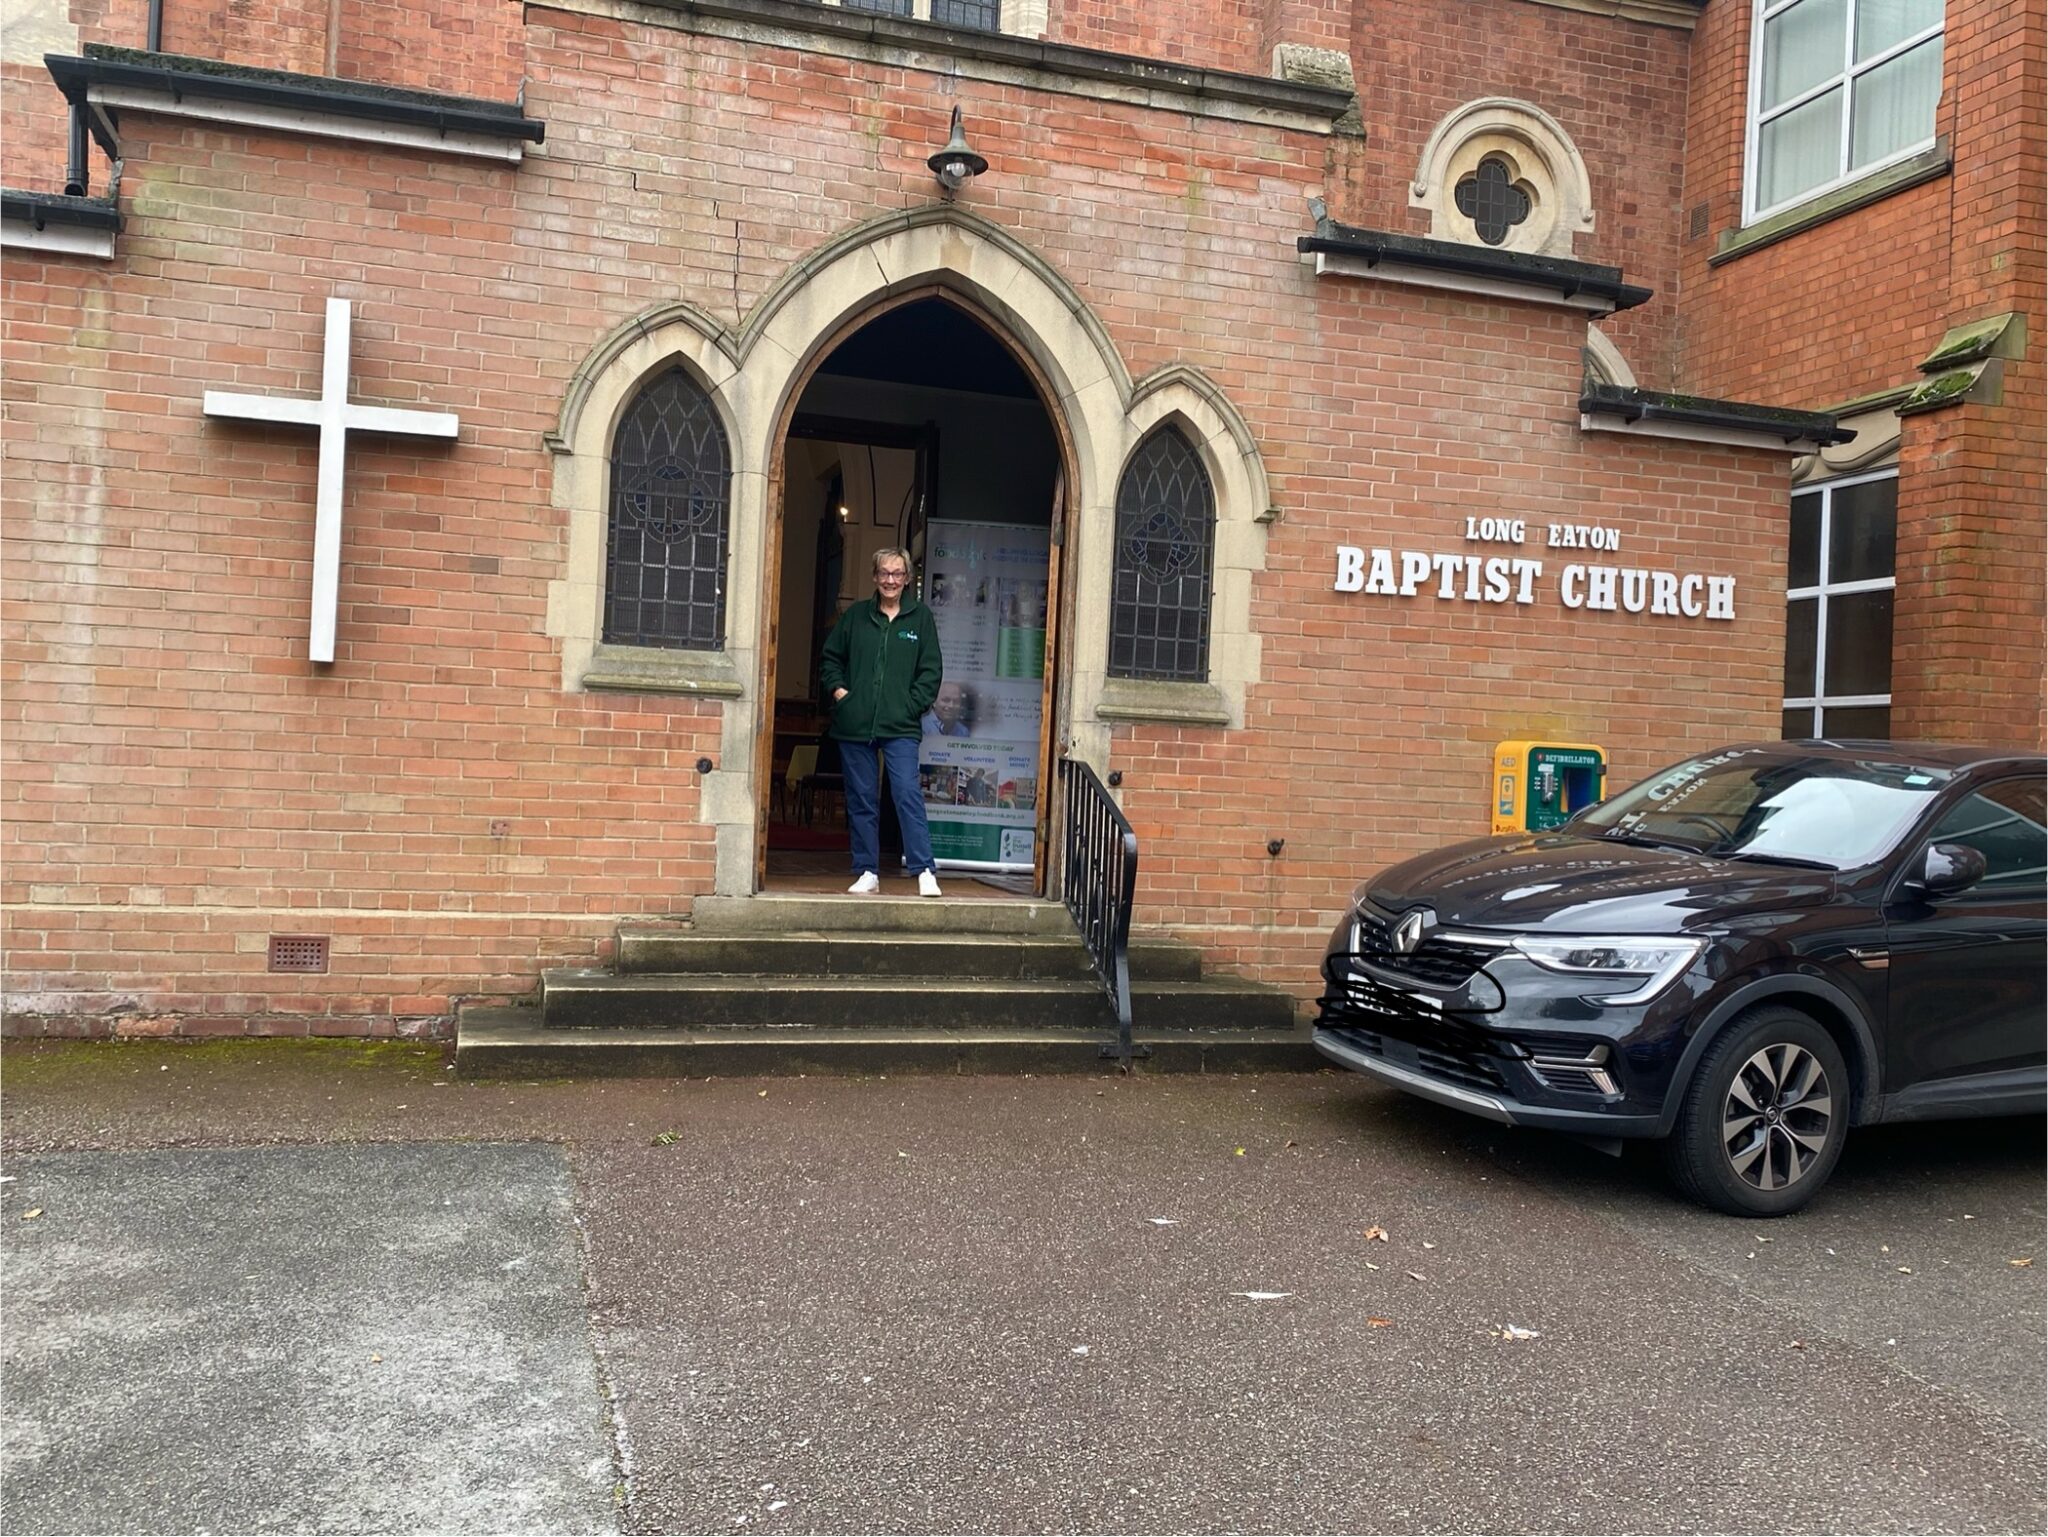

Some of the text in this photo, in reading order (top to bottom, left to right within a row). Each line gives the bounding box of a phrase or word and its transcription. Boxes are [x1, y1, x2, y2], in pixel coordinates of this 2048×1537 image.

[1465, 516, 1621, 552] LONG EATON
[1333, 545, 1737, 621] BAPTIST CHURCH
[960, 743, 992, 751] INVOLVED
[1545, 754, 1595, 765] DEFIBRILLATOR
